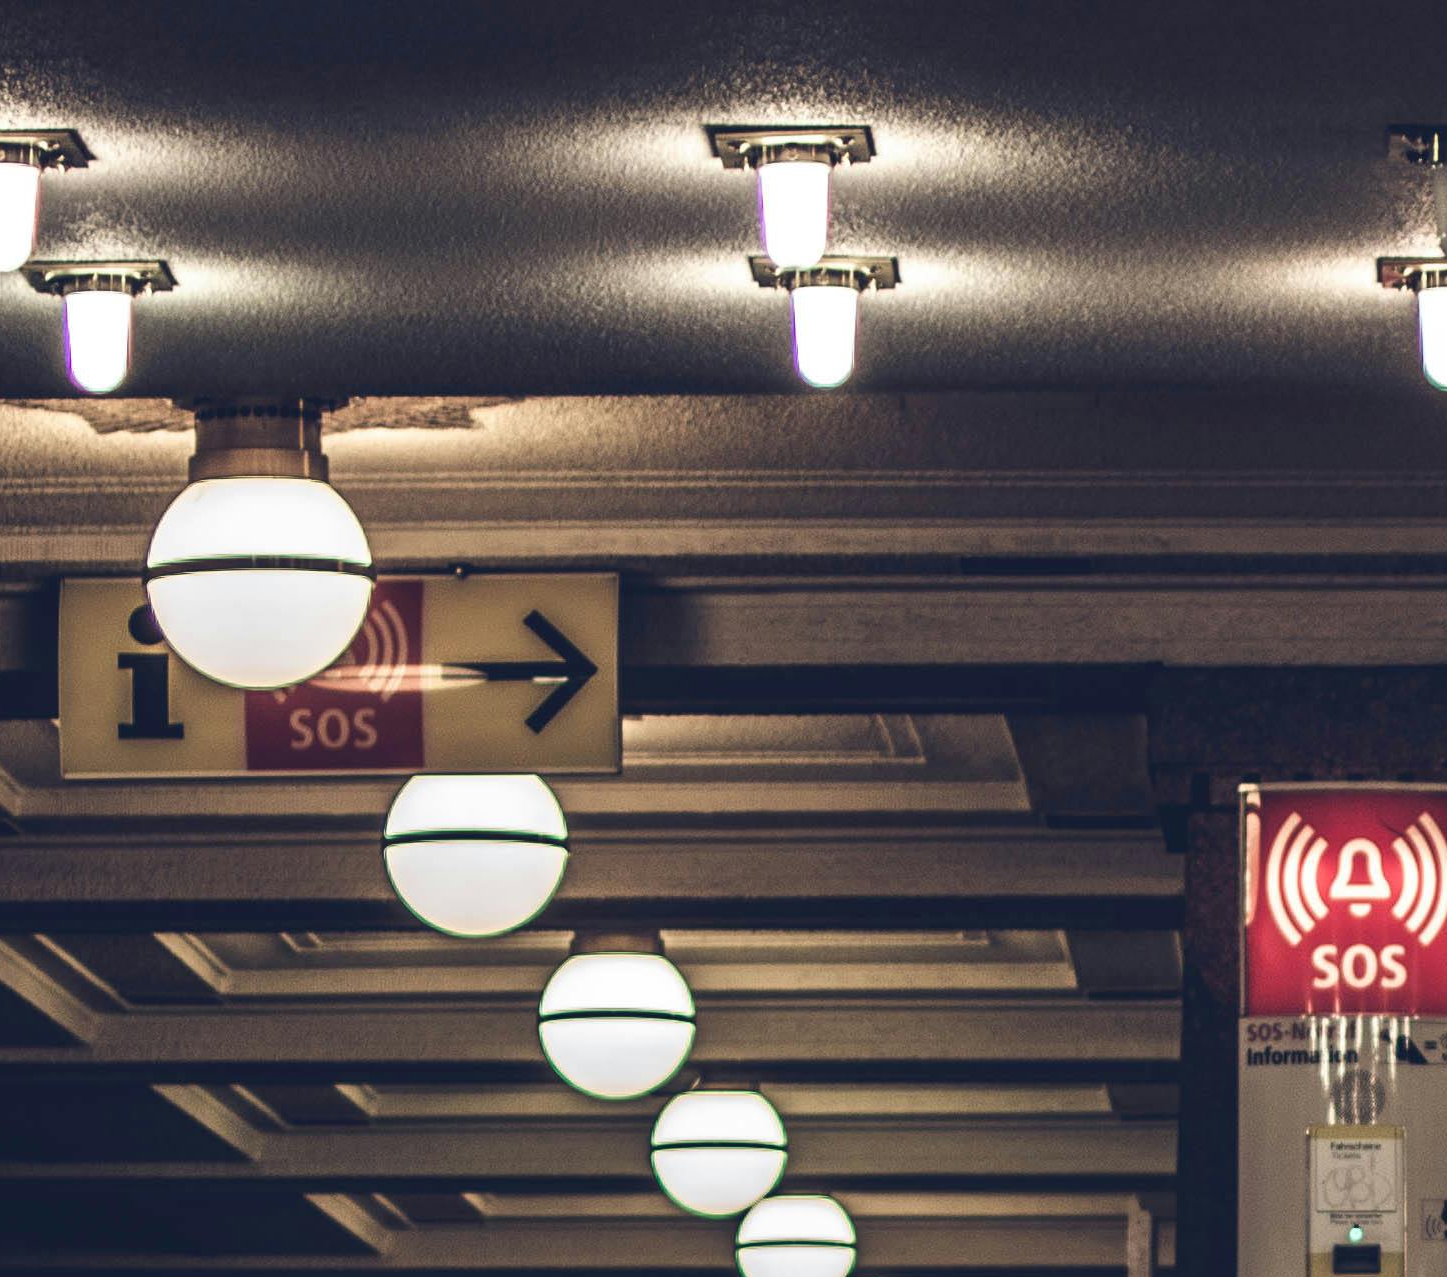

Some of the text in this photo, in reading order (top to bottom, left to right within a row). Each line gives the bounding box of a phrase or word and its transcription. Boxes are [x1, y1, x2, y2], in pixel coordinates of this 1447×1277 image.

[118, 604, 184, 739] i
[289, 708, 378, 749] SOS
[1311, 943, 1407, 989] SOS
[1247, 1046, 1358, 1066] Informaion
